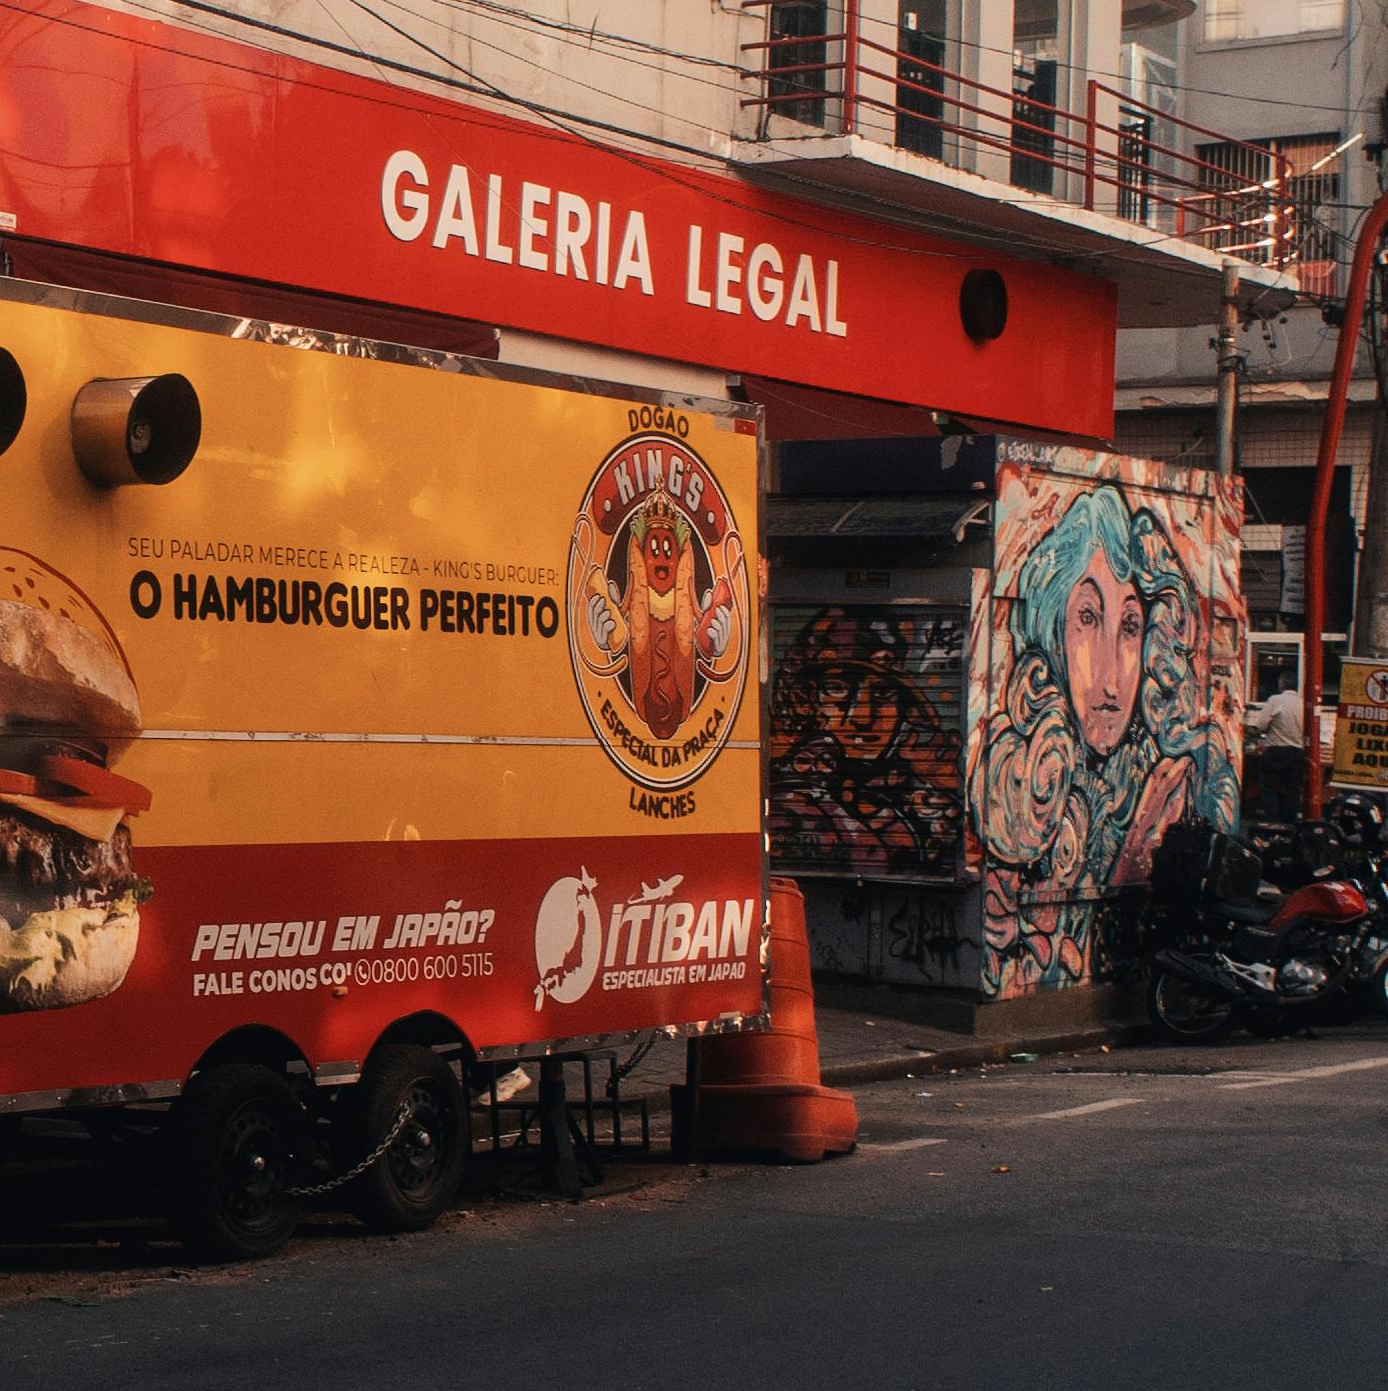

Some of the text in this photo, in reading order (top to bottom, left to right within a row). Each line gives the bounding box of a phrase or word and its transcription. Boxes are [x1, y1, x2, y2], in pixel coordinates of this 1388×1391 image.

[381, 150, 847, 338] GALERIA LEGAL
[628, 402, 690, 438] DOGÃO
[613, 449, 704, 512] KING'S
[128, 537, 164, 559] SEU
[170, 539, 254, 564] PALADAR
[259, 546, 329, 569] MERECE
[332, 552, 344, 570] A
[348, 554, 421, 576] REALEZA
[433, 559, 482, 580] KING'S
[486, 564, 560, 586] BURGUER:
[130, 570, 559, 639] O HAMBURGUER PERFEITO
[601, 698, 724, 768] ESPECIAL DA PRAÇA
[629, 787, 696, 819] LANCHES
[191, 900, 495, 962] PENSOU EM JAPÃO?
[193, 971, 243, 996] FALE
[371, 958, 419, 983] 0800
[423, 954, 457, 980] 600
[461, 952, 494, 977] 5115
[602, 966, 685, 990] ESPECIALISTA
[689, 964, 707, 983] EM
